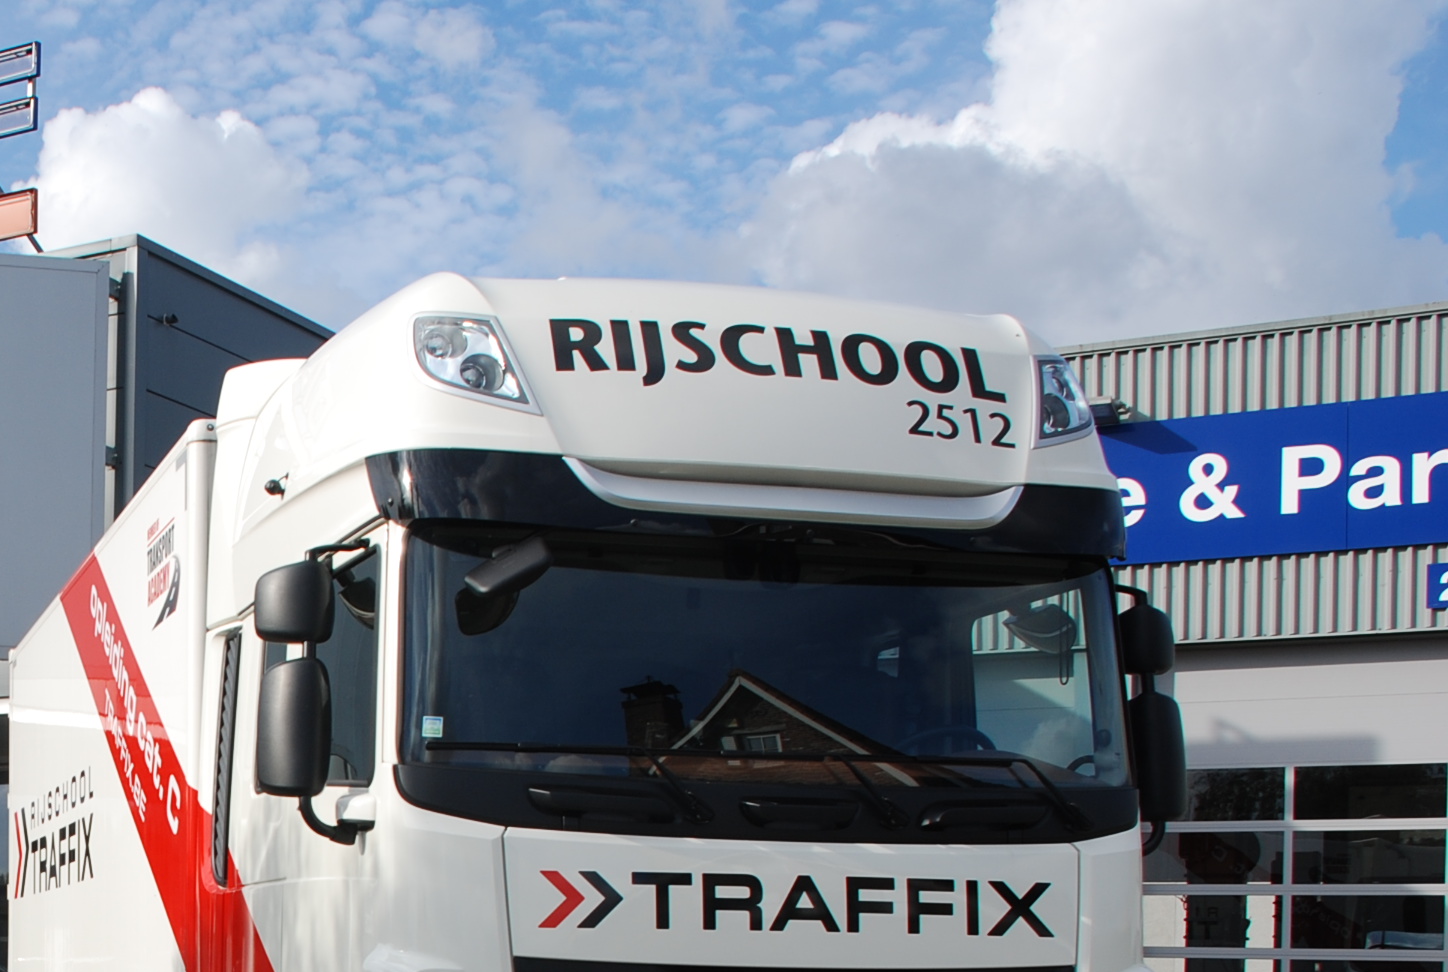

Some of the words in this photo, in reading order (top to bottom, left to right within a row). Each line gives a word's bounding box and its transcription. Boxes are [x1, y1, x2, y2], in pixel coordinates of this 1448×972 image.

[548, 318, 1007, 404] RIJSCHOOL
[906, 400, 1017, 449] 2512
[1179, 453, 1245, 522] &
[89, 584, 137, 736] opleiding
[166, 774, 181, 835] C
[104, 687, 147, 822] TRAFFIX.BE
[30, 765, 94, 830] RIJSCHOOL
[31, 812, 94, 895] TRAFFIX
[631, 871, 1055, 938] TRAFFIX
